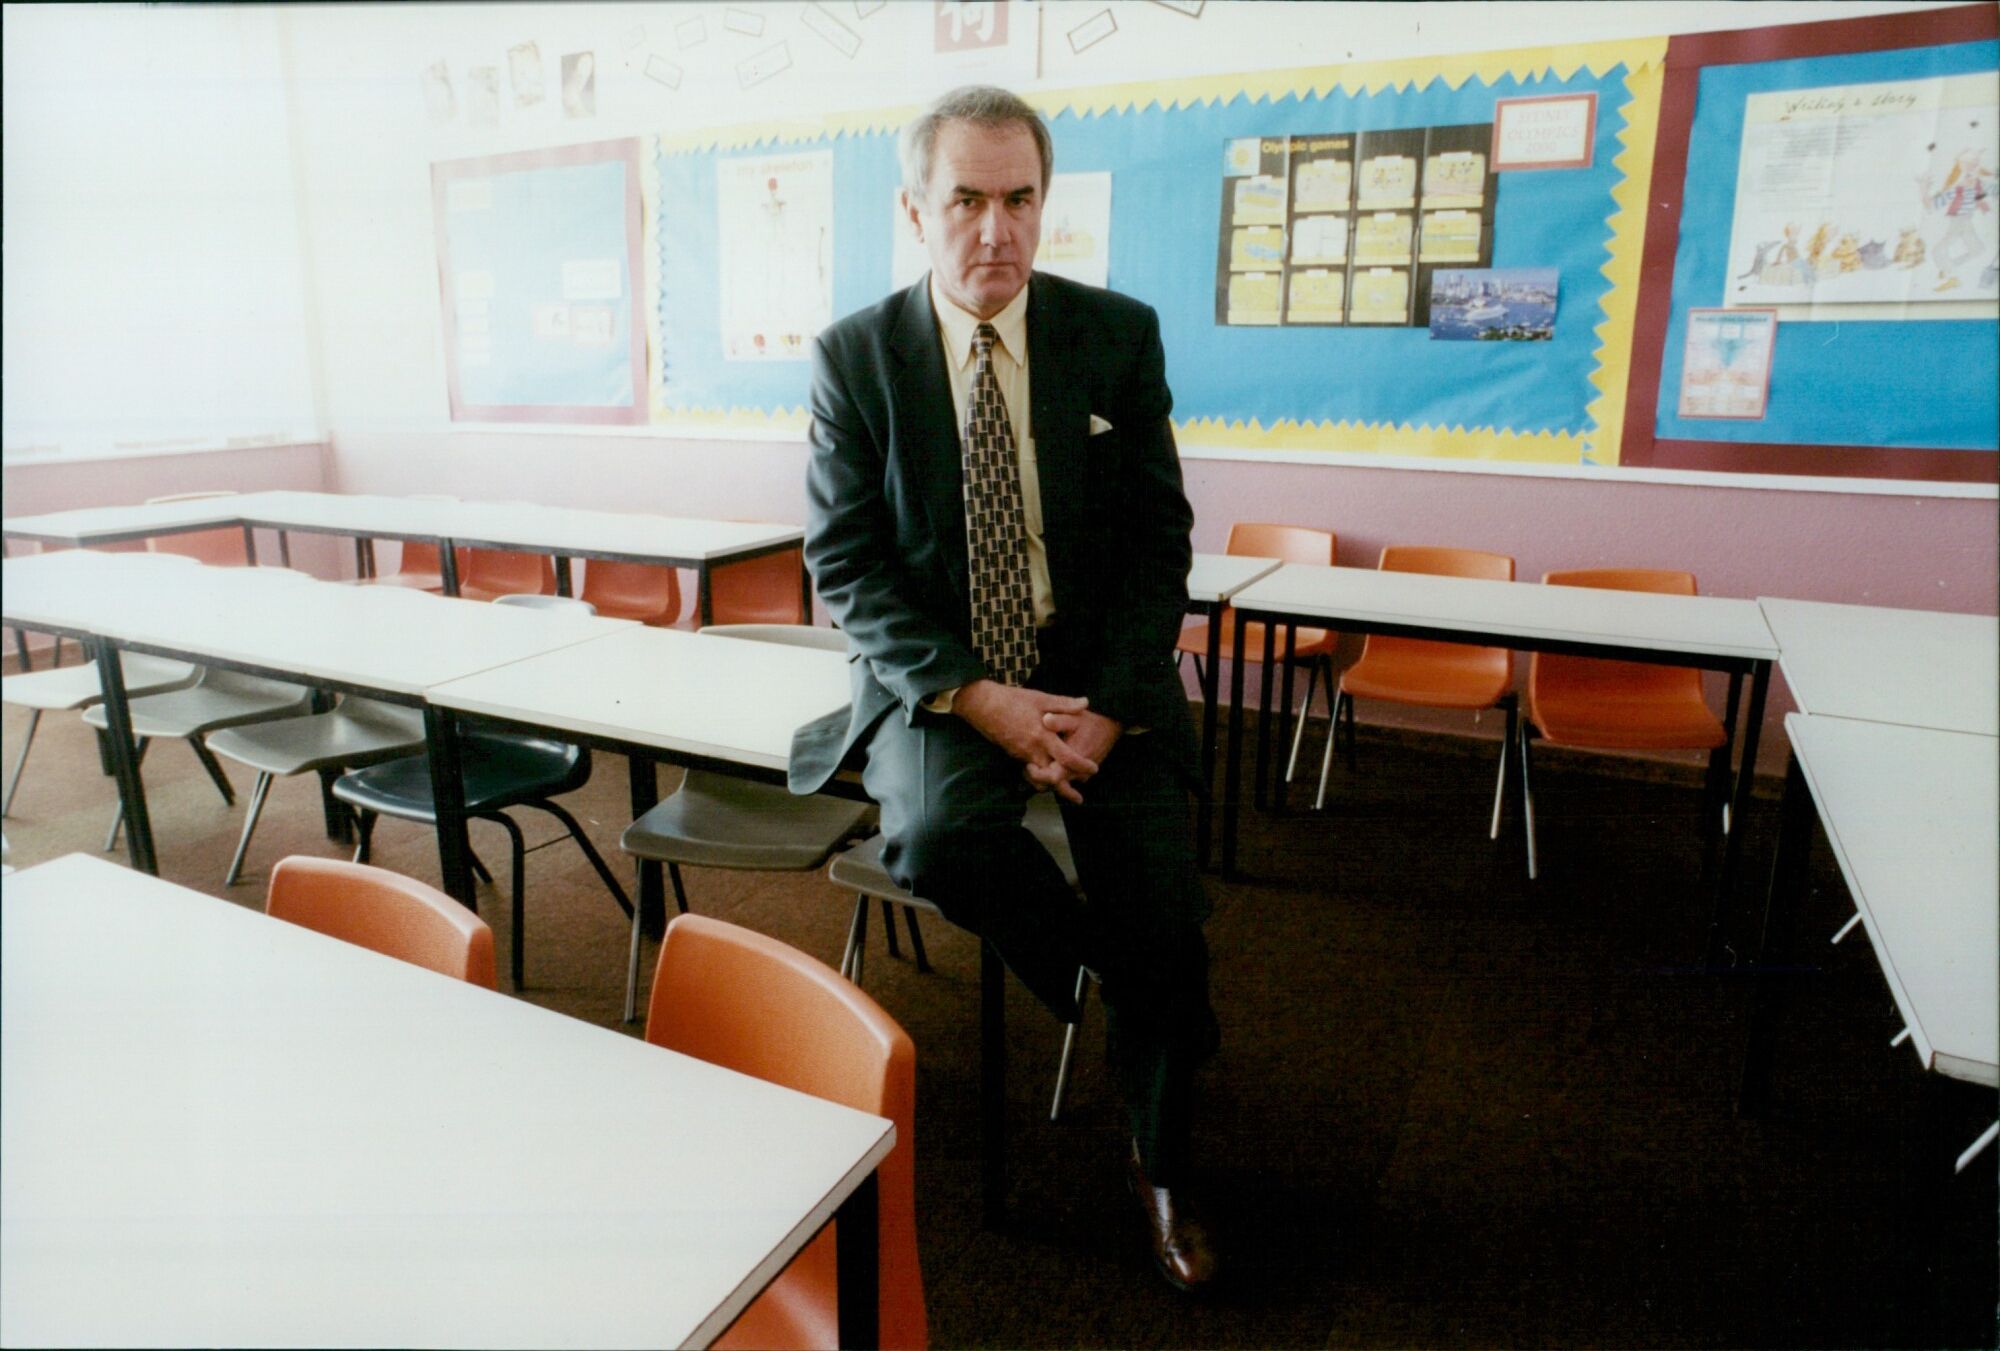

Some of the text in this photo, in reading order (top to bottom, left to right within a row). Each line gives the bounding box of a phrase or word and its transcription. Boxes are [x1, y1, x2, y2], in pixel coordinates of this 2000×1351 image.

[1786, 95, 1845, 114] Writing
[1871, 92, 1918, 108] story
[1310, 140, 1349, 154] games
